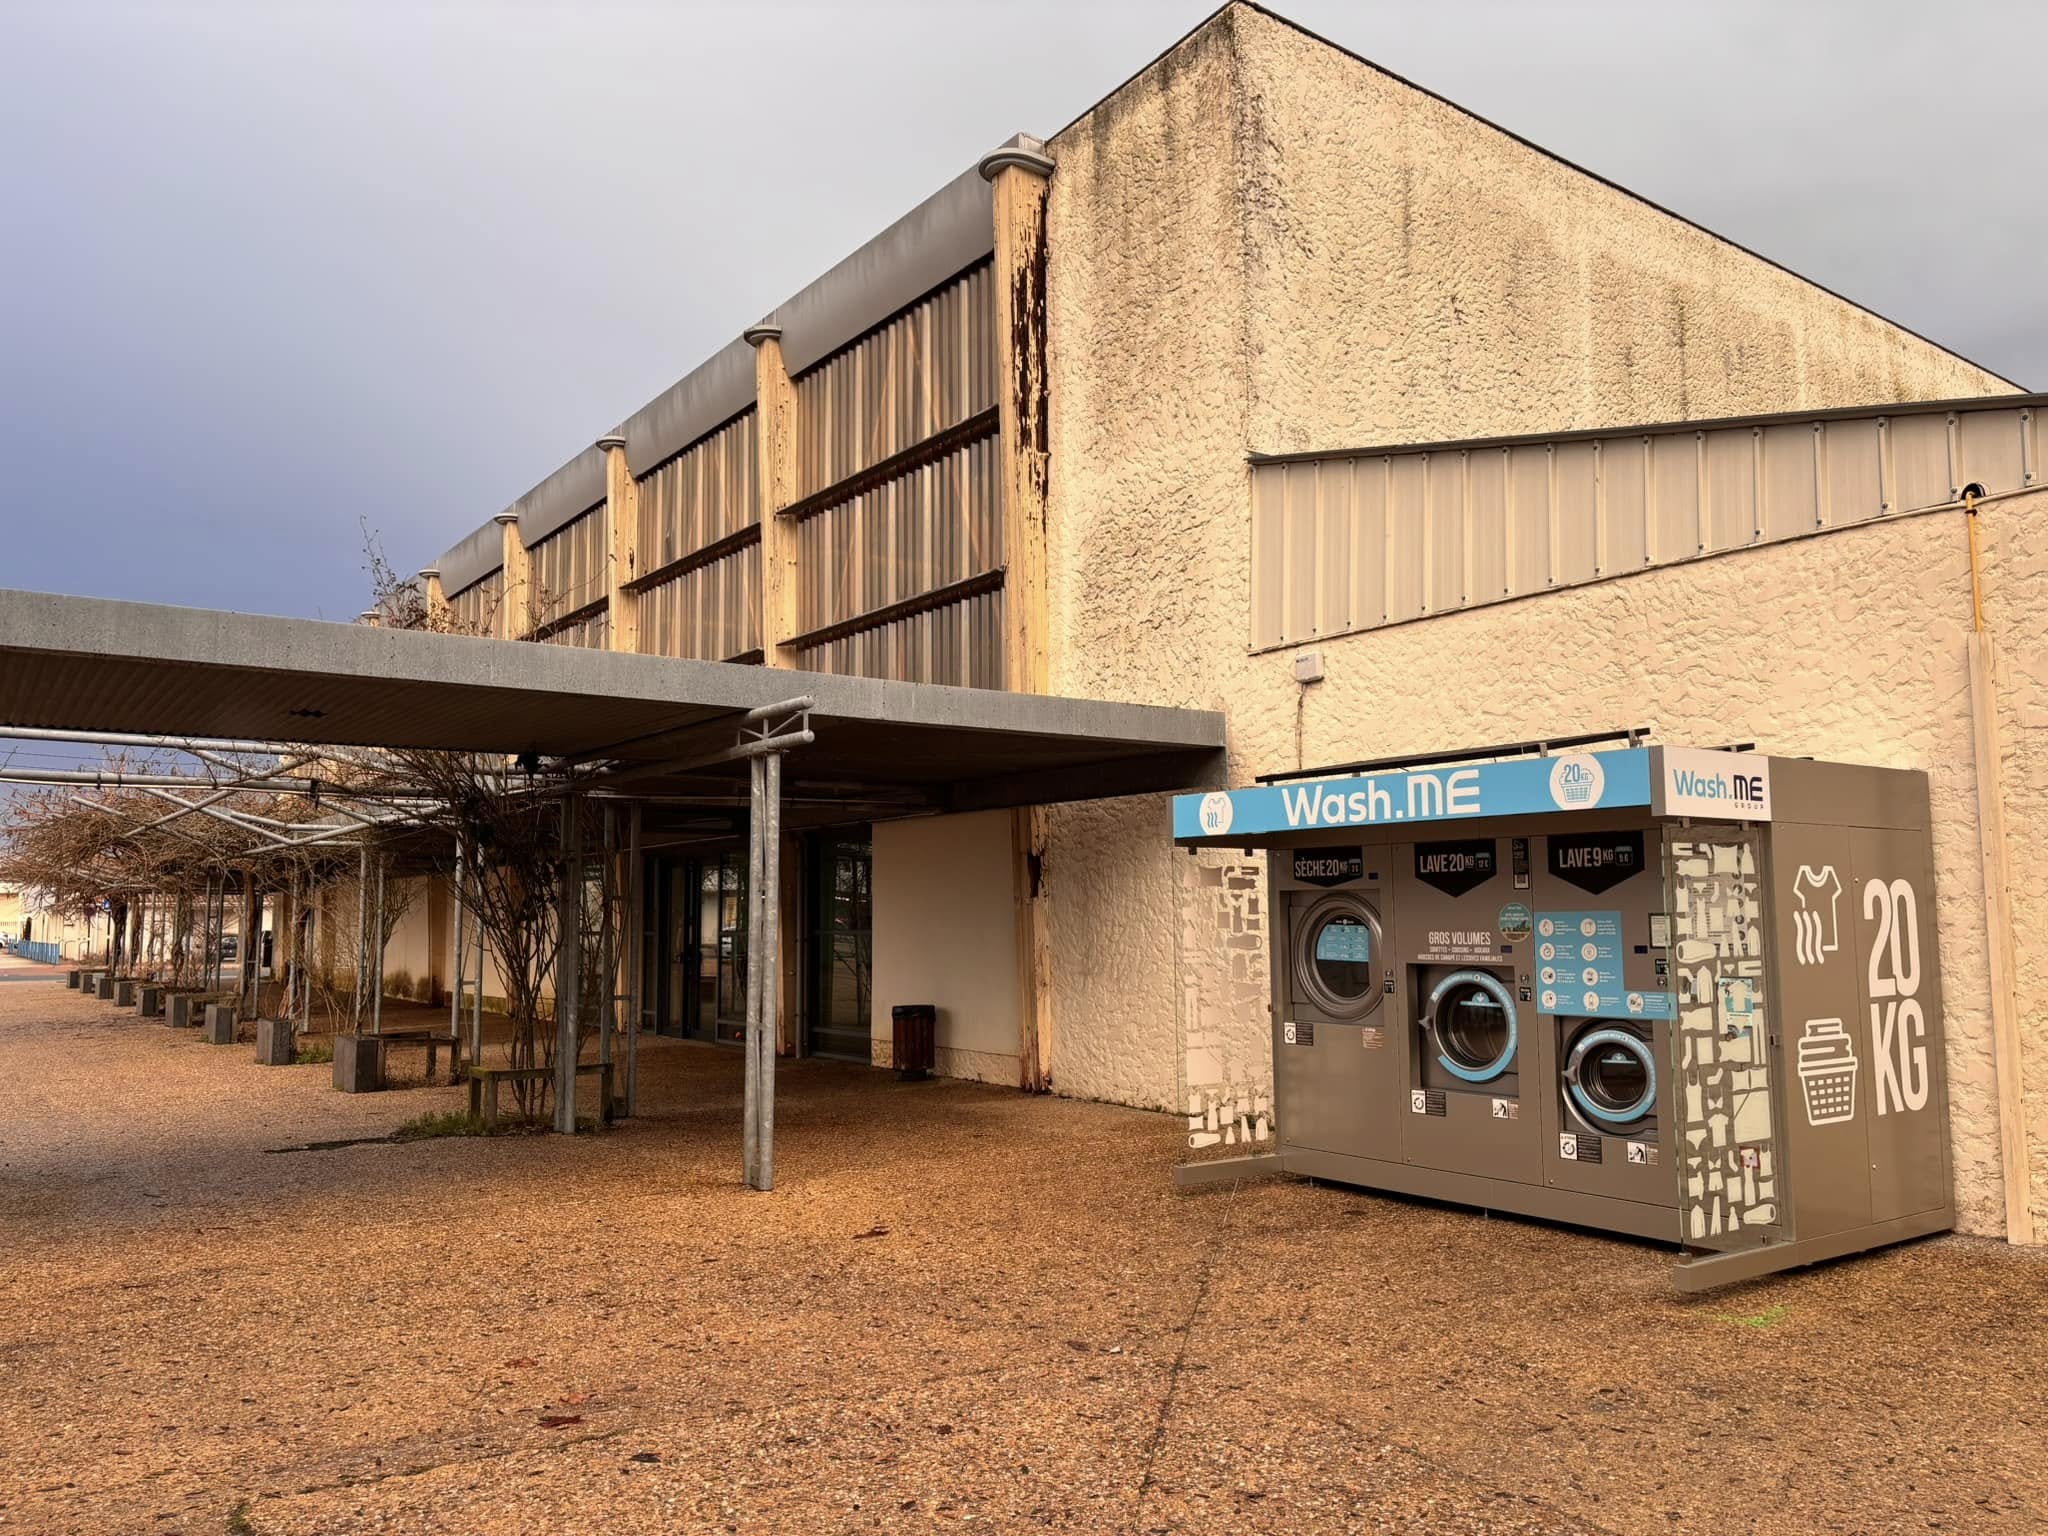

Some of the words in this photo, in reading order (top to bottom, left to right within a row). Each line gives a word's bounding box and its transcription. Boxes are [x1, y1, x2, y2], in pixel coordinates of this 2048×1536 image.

[1295, 857, 1325, 877] SÈCHE
[1419, 854, 1448, 873] LAVE
[1559, 847, 1592, 868] LAVE
[1428, 931, 1450, 944] GROS
[1452, 931, 1491, 945] VOLUMES
[1864, 878, 1921, 998] 20
[1869, 998, 1928, 1116] KG
